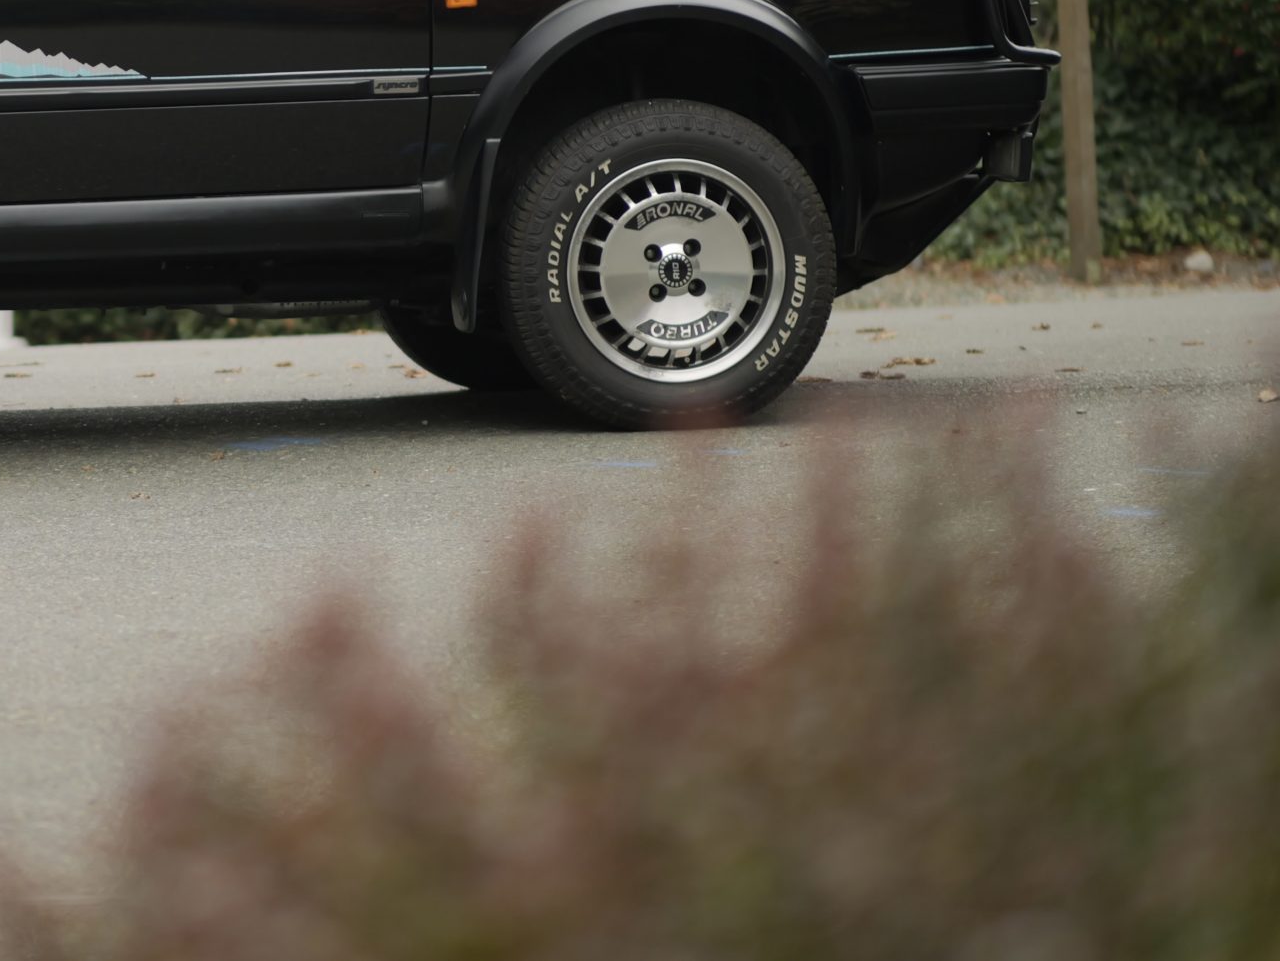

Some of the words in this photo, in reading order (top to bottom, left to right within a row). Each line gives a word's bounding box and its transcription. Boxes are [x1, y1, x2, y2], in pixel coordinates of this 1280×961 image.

[546, 210, 574, 303] RADIAL
[574, 159, 612, 203] A/T
[645, 202, 705, 222] RONAL
[650, 313, 717, 338] TURBO
[755, 254, 807, 372] MUDSTAR
